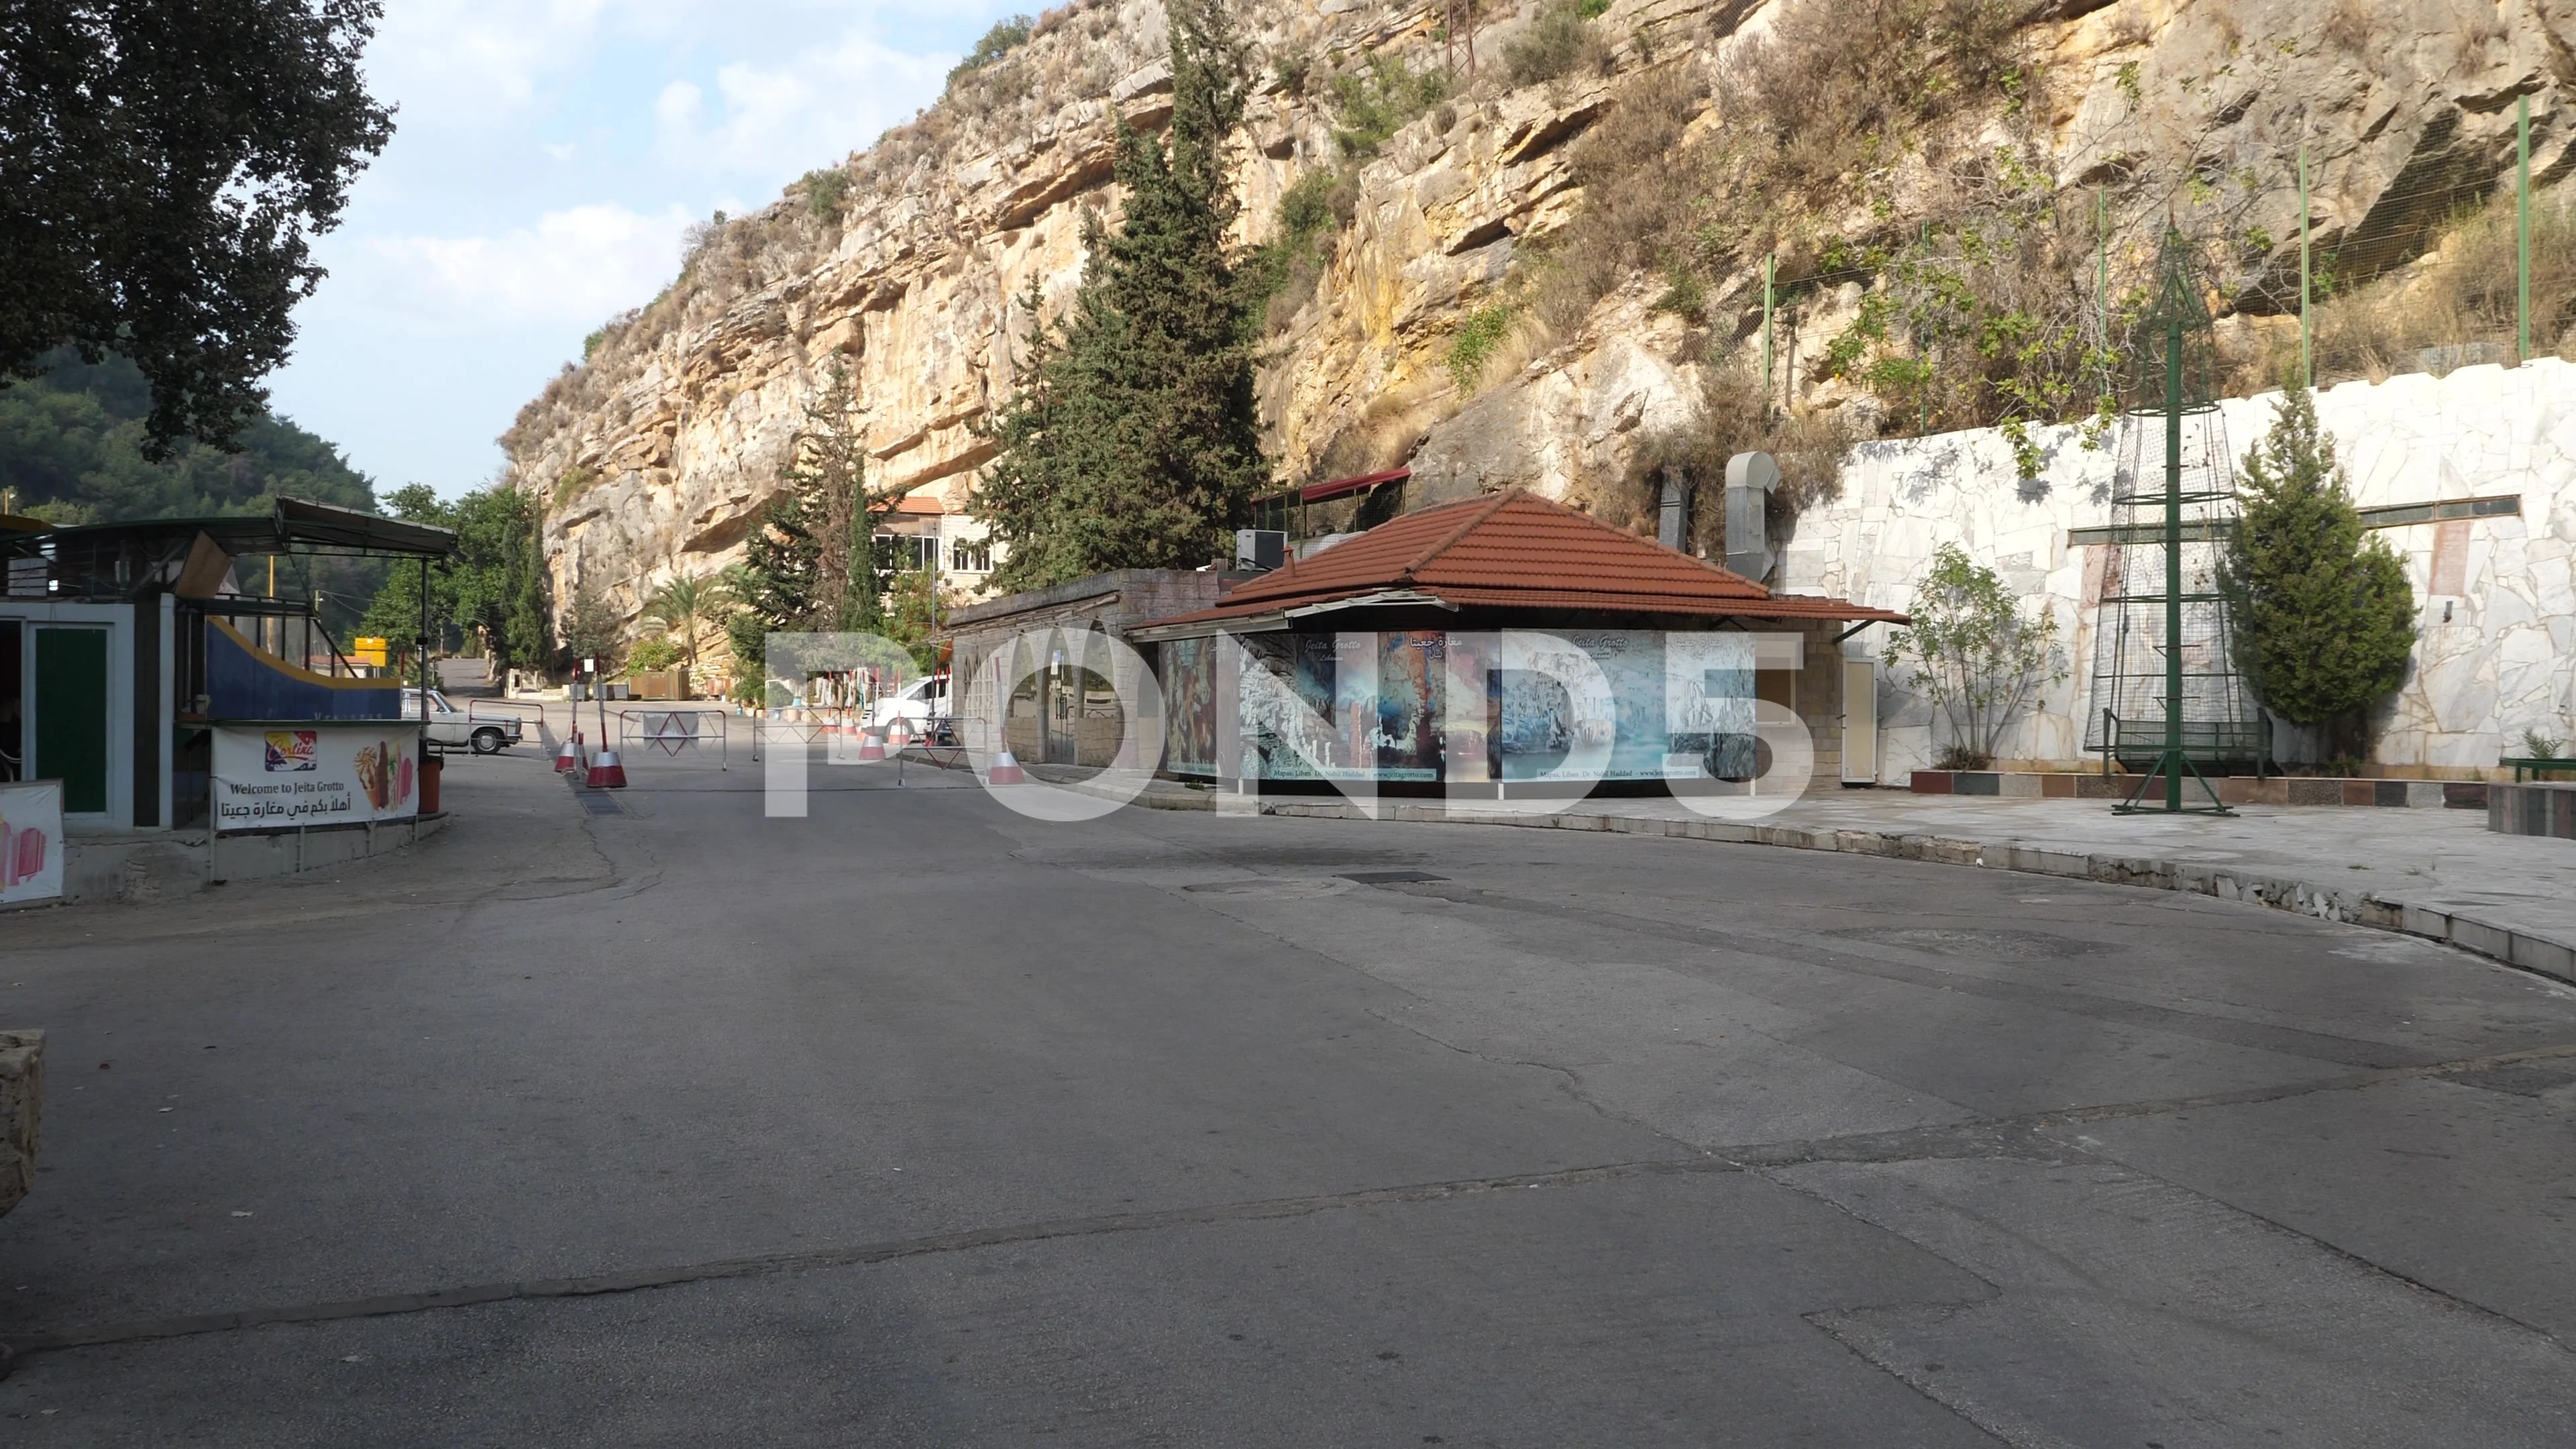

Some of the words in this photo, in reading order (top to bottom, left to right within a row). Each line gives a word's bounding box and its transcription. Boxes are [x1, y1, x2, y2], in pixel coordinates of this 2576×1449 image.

[1305, 639, 1328, 653] Jeita
[1332, 638, 1361, 653] Grotto
[1409, 637, 1435, 649] جعيتا
[1438, 636, 1462, 648] مغارة
[1599, 635, 1628, 650] Grotto
[268, 739, 315, 761] Cortina
[230, 784, 279, 794] Welcome
[282, 784, 292, 794] to
[294, 782, 315, 794] Jeita
[317, 781, 344, 792] Grotto
[221, 802, 250, 820] جعيتا
[253, 802, 284, 818] مغارة
[286, 800, 309, 820] في
[310, 799, 328, 817] بكم
